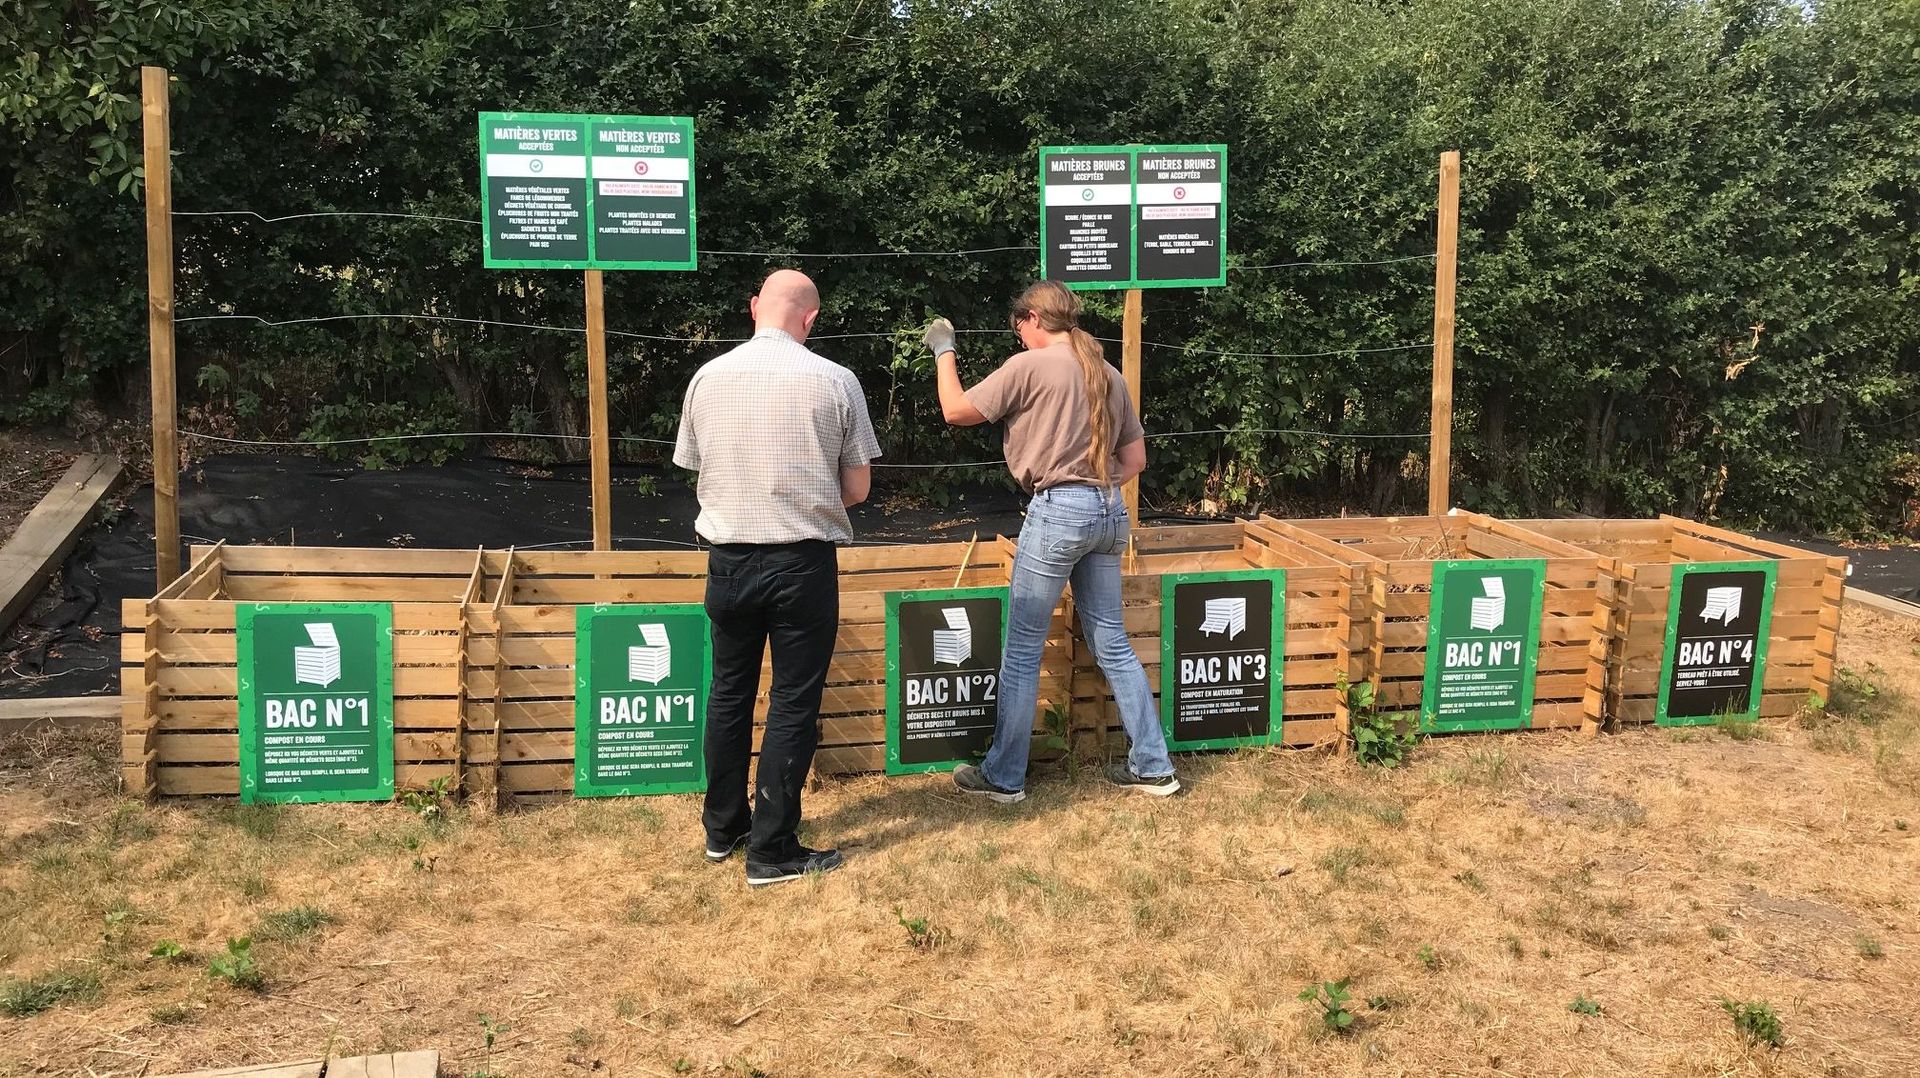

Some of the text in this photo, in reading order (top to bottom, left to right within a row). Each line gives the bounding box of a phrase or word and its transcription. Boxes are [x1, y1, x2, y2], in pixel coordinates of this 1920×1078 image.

[494, 126, 577, 141] MATIÈRES VERTES
[600, 128, 680, 143] MATIÈRES VERTES
[519, 141, 554, 151] ACCEPTÉES
[630, 144, 665, 153] ACCEPTÉES
[1051, 158, 1125, 172] MATIÈRES BRUNES
[1143, 157, 1215, 170] MATIÈRES BRUNES
[1073, 172, 1104, 181] ACCEPTÉES
[1170, 170, 1200, 179] ACCEPTÉES
[1445, 641, 1521, 667] BAC N°1
[1679, 640, 1752, 666] BAC N°4
[1181, 654, 1266, 684] BAC N°3
[907, 674, 996, 706] BAC N°2
[1181, 690, 1204, 699] COMPOST
[1213, 688, 1243, 697] MATURATION
[266, 698, 368, 728] BAC N°1
[601, 695, 694, 724] BAC N°1
[907, 711, 930, 720] DÉCHETS
[931, 711, 943, 719] SECS
[952, 709, 969, 717] BRUNS
[981, 707, 985, 715] À
[907, 720, 955, 729] VOTRE DISPOSITION
